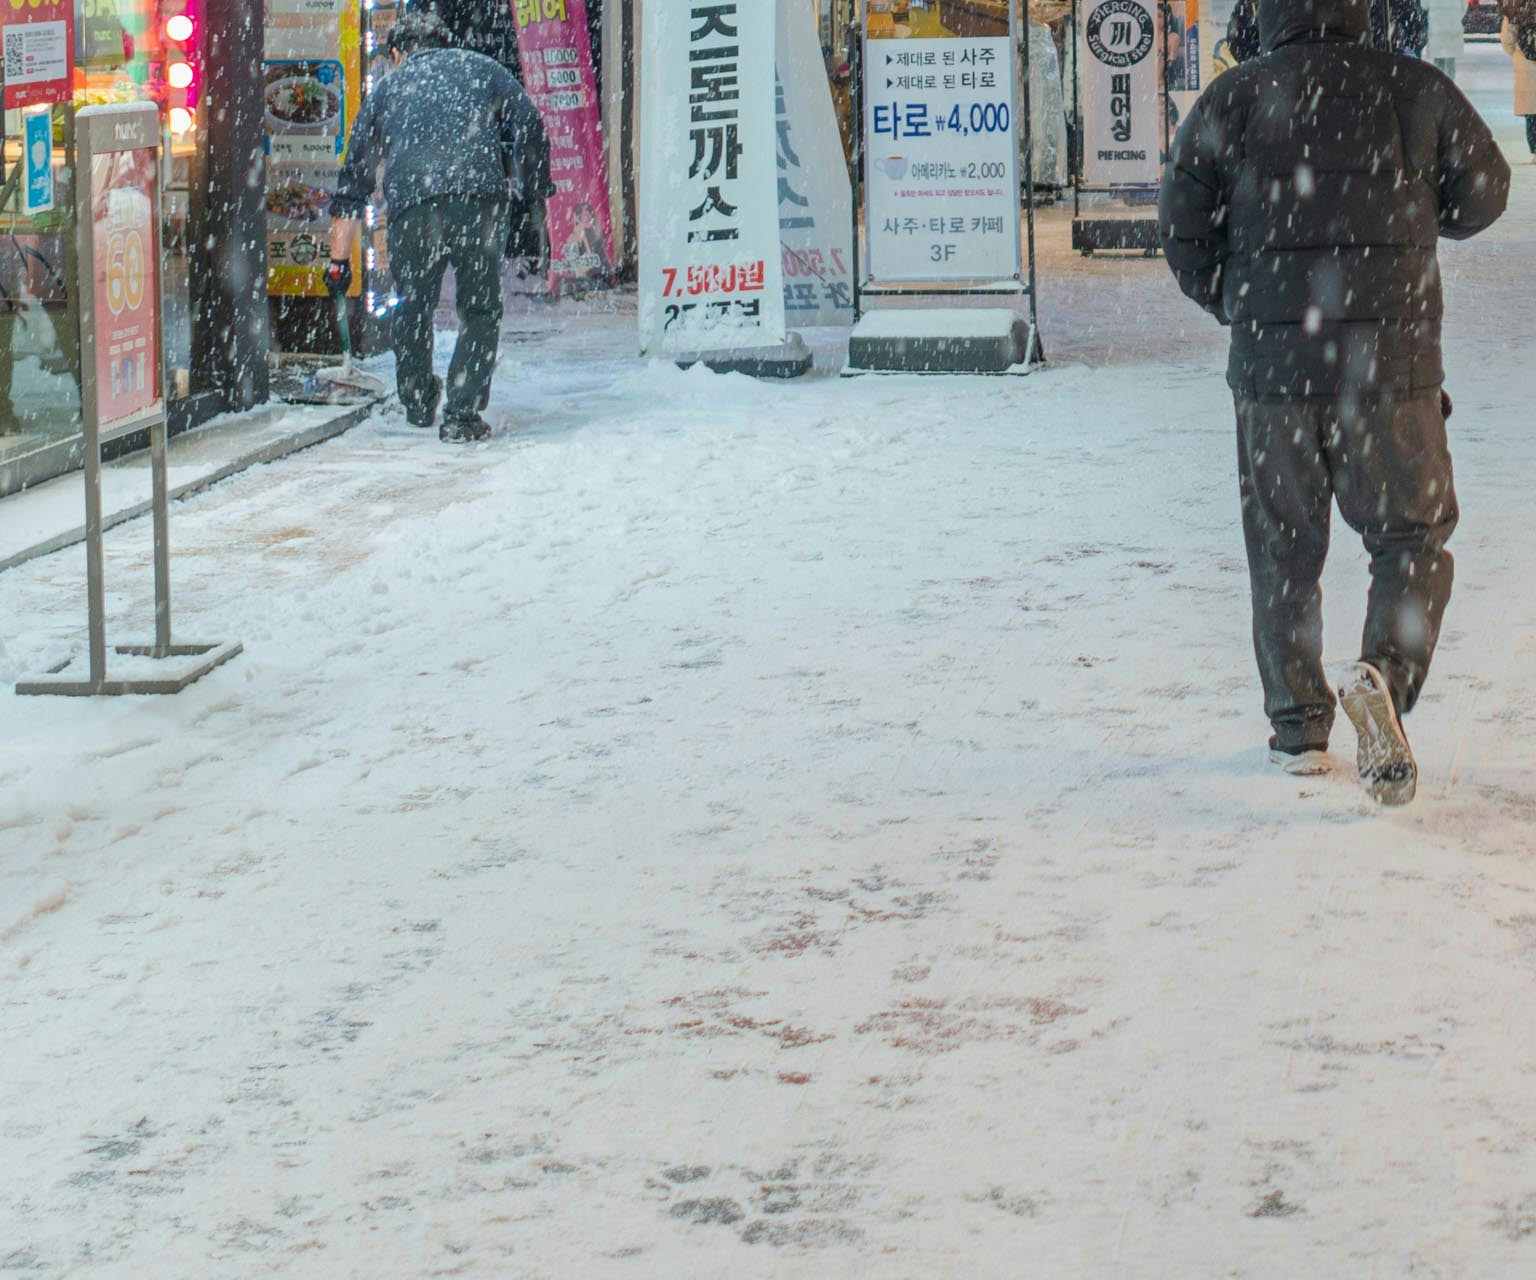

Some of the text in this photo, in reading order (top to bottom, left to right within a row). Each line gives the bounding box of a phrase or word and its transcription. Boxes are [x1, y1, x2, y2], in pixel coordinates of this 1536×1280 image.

[1092, 1, 1149, 27] PIERCING
[896, 47, 996, 66] 제대로 된 사주
[896, 71, 996, 90] 제대로 된 타로
[1110, 73, 1132, 143] 피어싱
[872, 101, 932, 141] 타로
[1097, 150, 1147, 161] PIERCING
[911, 161, 957, 181] 아메리카노
[971, 215, 1004, 234] 카페
[929, 244, 957, 262] 3F
